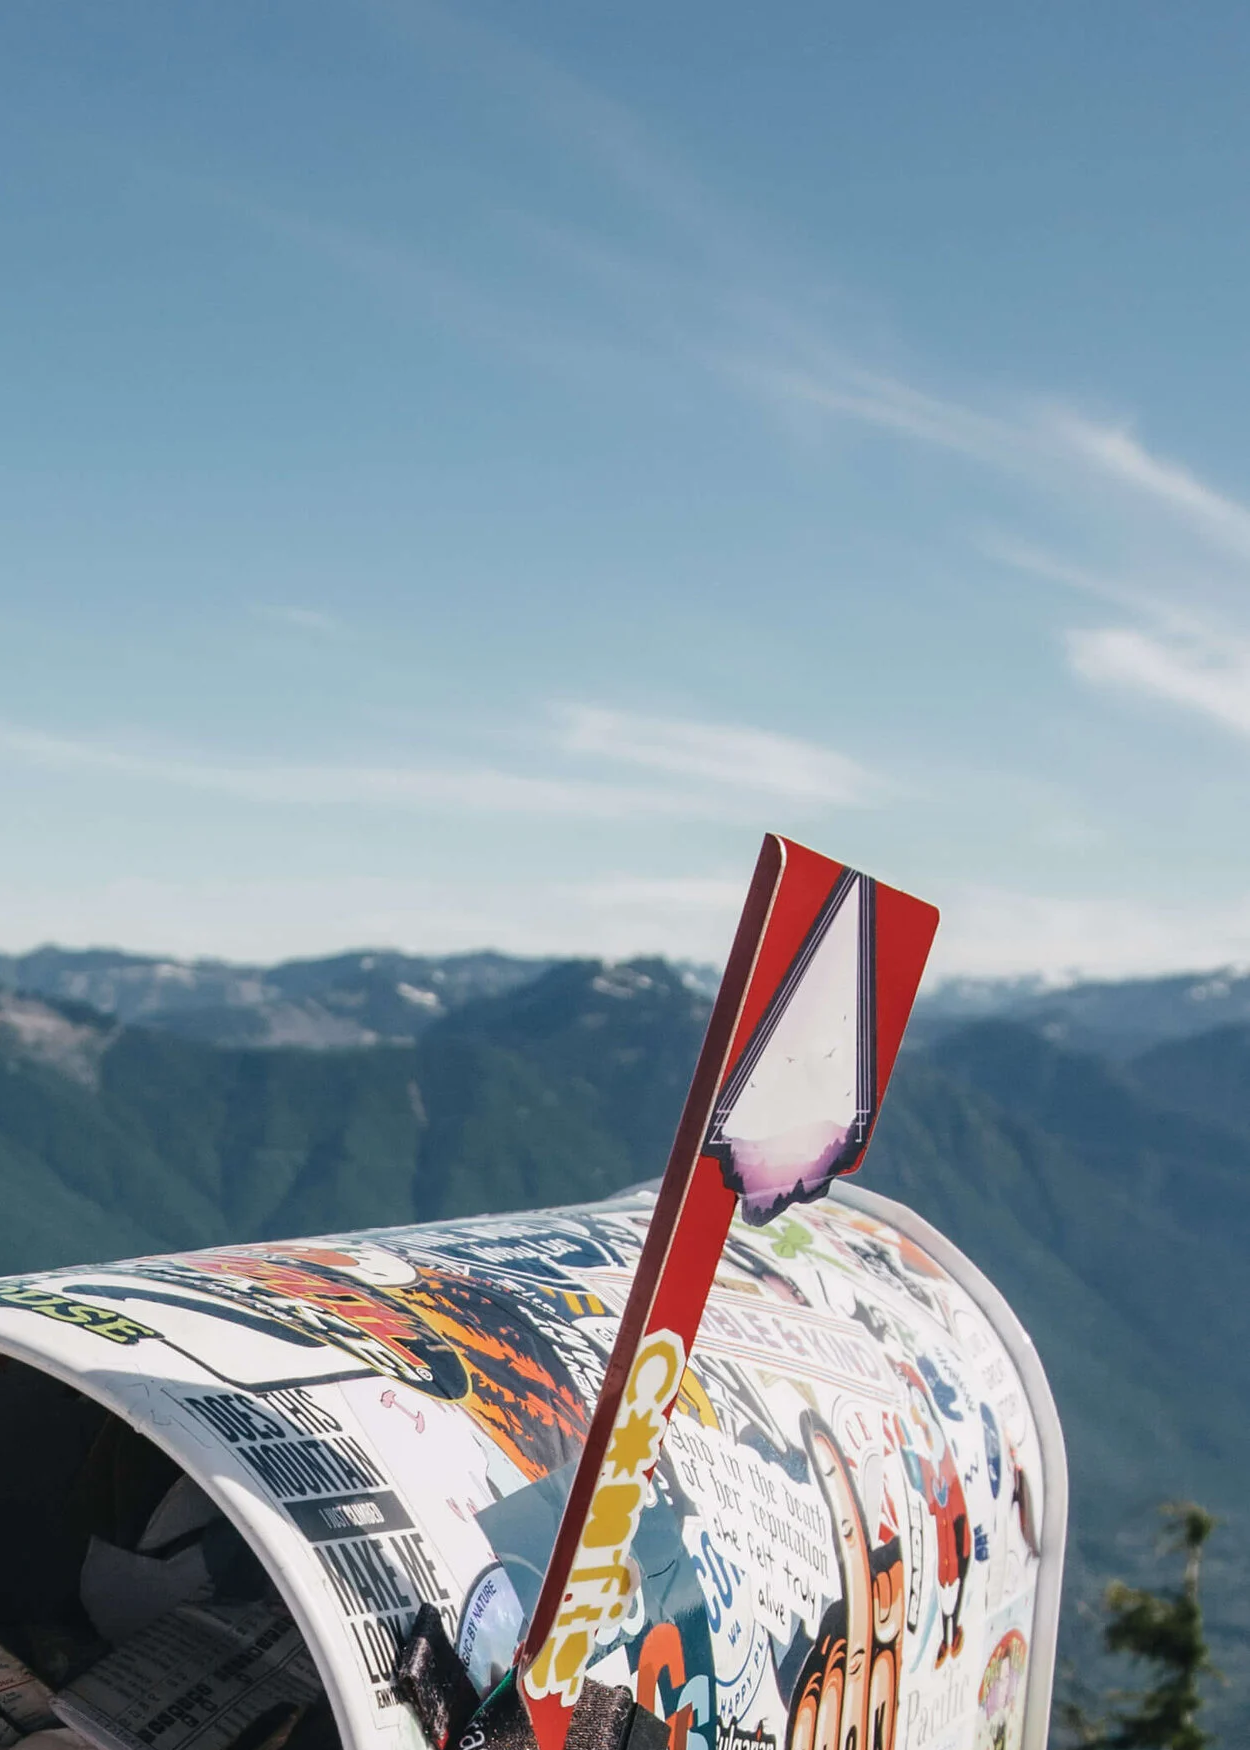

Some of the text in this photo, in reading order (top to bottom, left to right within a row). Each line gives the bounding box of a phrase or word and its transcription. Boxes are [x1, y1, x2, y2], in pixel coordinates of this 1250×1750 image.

[184, 1388, 343, 1443] DOES THIS
[236, 1435, 389, 1499] MOUNTAIN
[720, 1451, 744, 1484] in
[748, 1463, 778, 1506] the
[781, 1482, 828, 1546] death
[680, 1458, 830, 1581] of her reputation
[313, 1532, 451, 1617] MAKE ME
[746, 1531, 776, 1569] felt
[782, 1559, 817, 1620] truly
[757, 1582, 786, 1627] alive
[466, 1618, 478, 1641] BY
[472, 1579, 498, 1624] NATURE
[727, 1619, 743, 1648] WA
